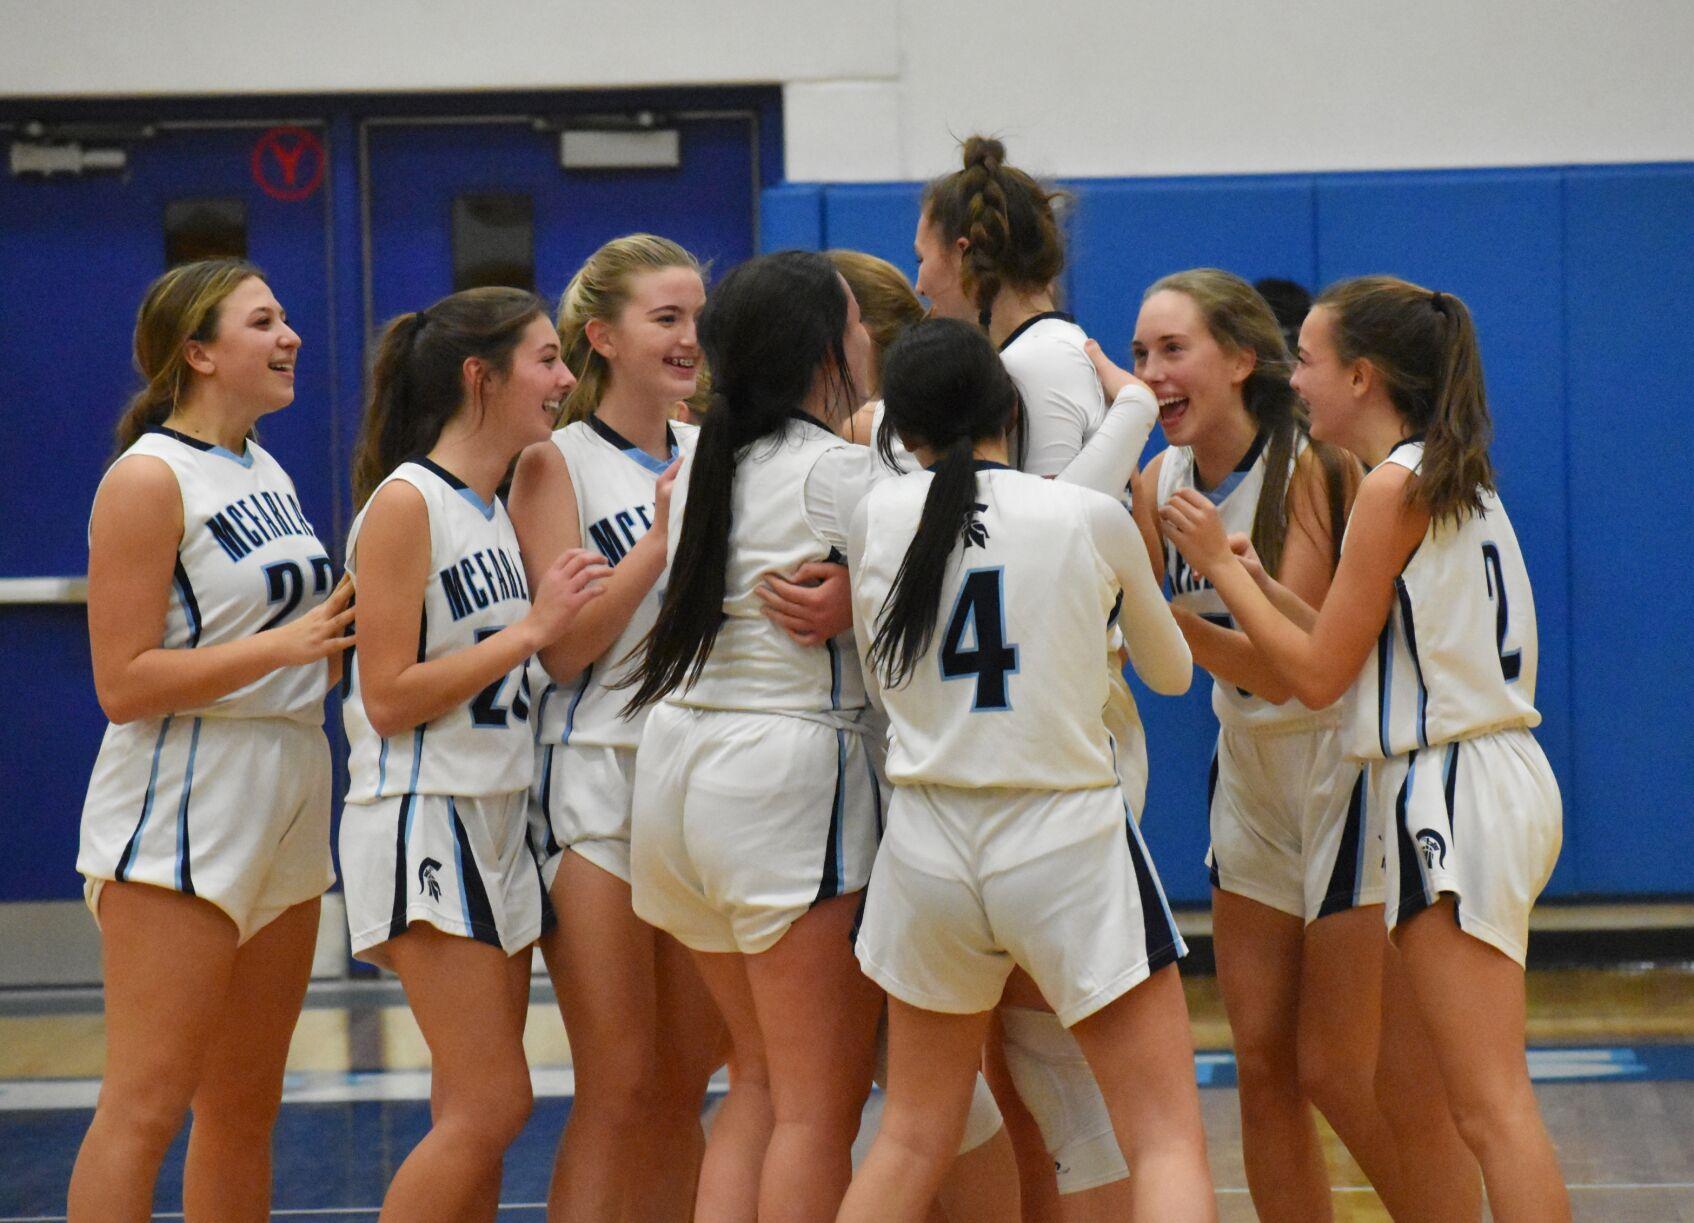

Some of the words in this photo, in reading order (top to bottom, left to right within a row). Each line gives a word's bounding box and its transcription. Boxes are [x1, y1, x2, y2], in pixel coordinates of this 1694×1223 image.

[588, 502, 656, 569] MCF
[938, 565, 1020, 713] 4
[1481, 540, 1522, 685] 2
